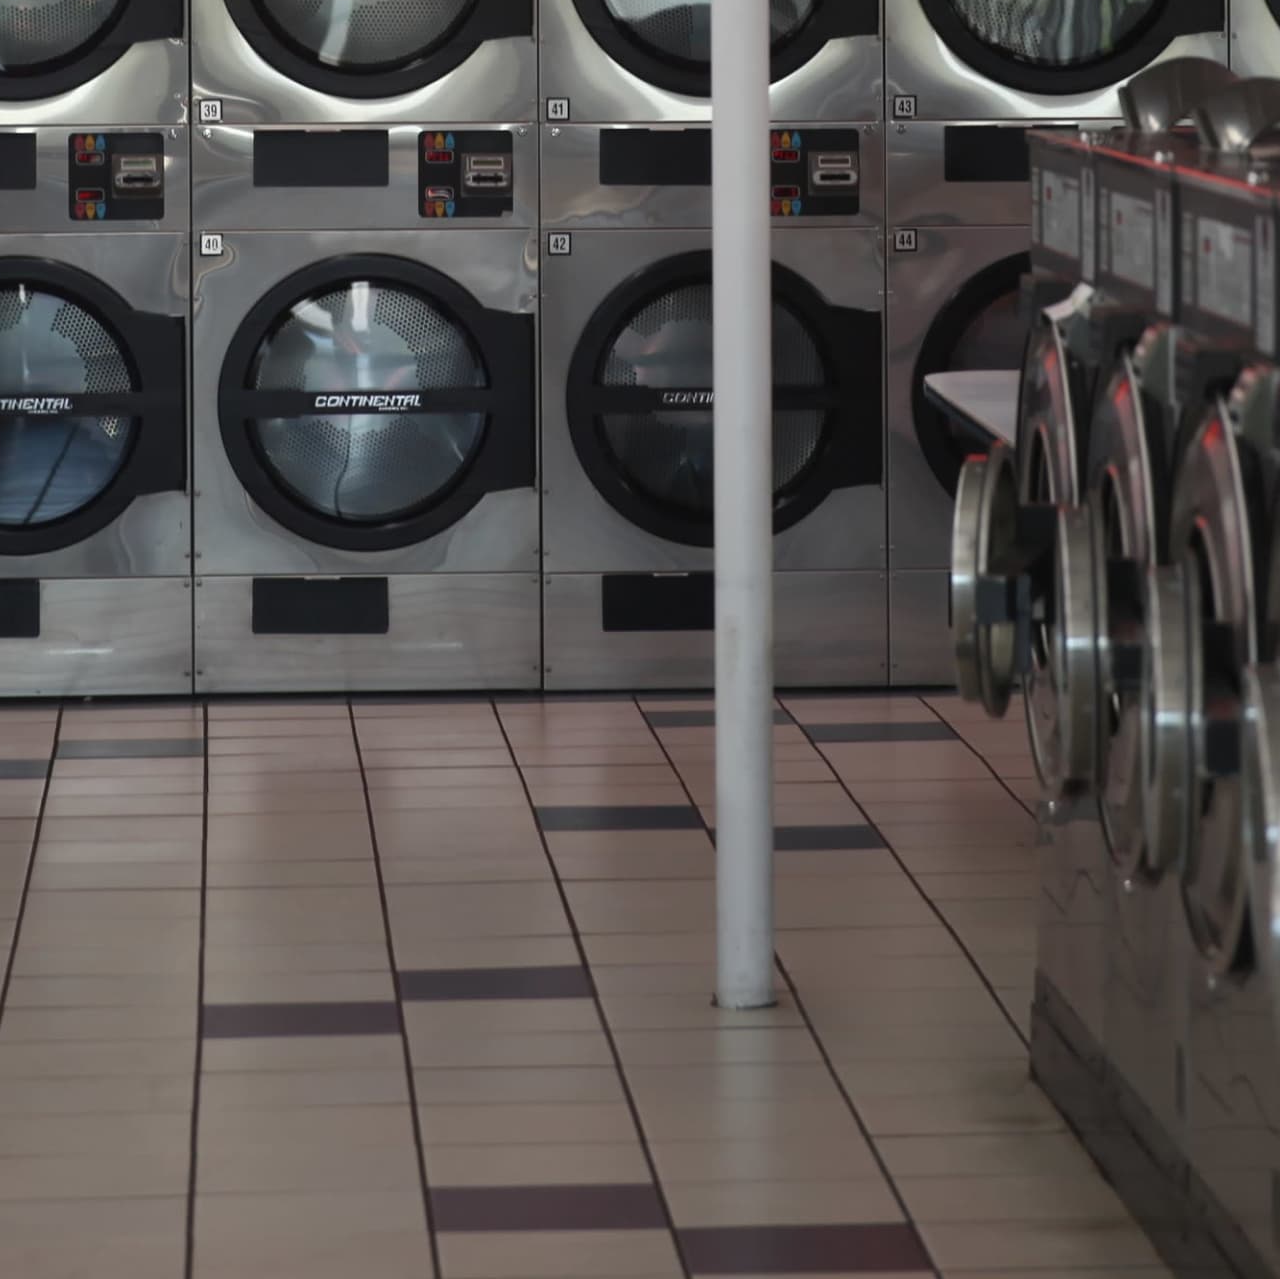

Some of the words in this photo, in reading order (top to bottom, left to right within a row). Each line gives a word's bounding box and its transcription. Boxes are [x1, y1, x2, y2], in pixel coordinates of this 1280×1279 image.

[204, 104, 217, 118] 39
[552, 103, 563, 115] 41
[898, 100, 912, 113] 43
[205, 238, 219, 251] 40
[553, 237, 566, 251] 42
[898, 232, 912, 247] 44
[315, 395, 421, 408] CONTINENTAL
